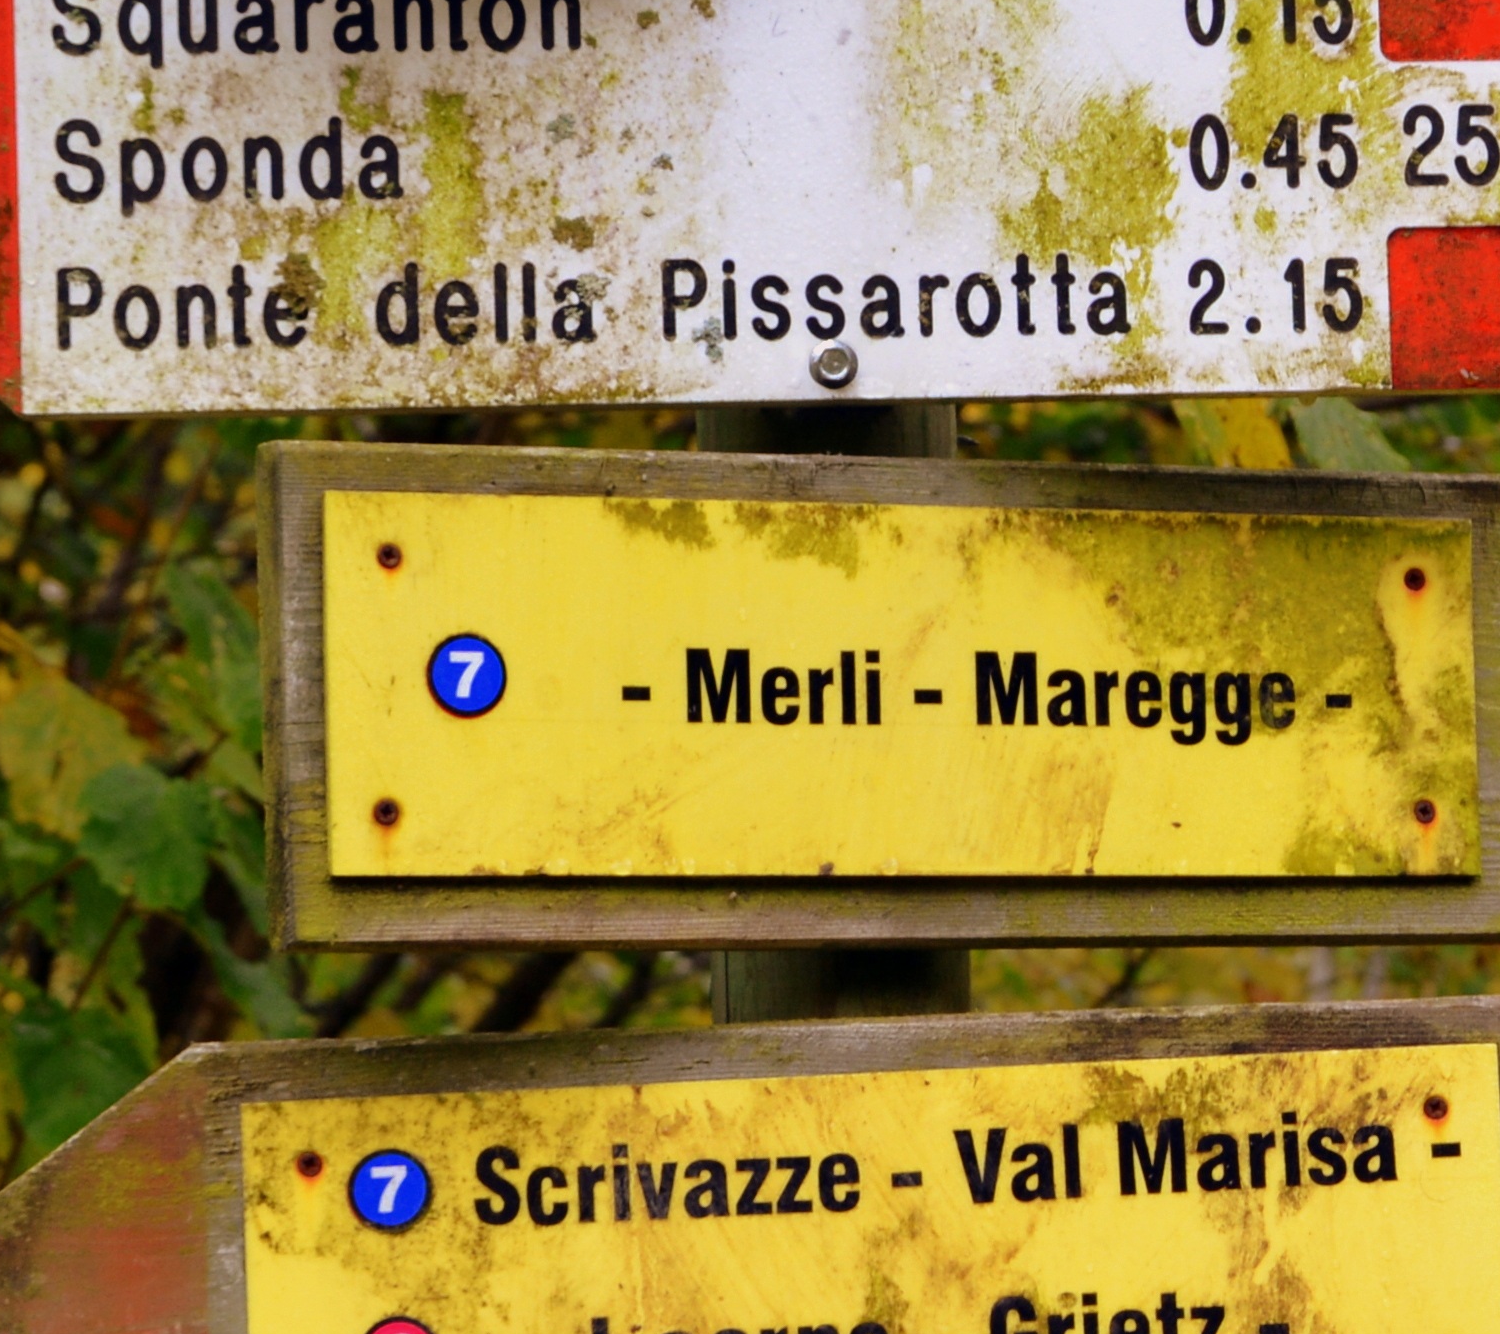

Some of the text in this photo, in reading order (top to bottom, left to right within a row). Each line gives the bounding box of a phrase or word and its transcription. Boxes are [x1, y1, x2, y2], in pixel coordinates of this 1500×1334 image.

[54, 113, 1359, 217] Sponda 0.45
[57, 252, 1364, 352] Ponte della Pissarotta 2.15
[449, 651, 485, 699] 7
[684, 648, 882, 726] Merli
[974, 651, 1296, 746] Maregge
[370, 1165, 408, 1213] 7
[474, 1144, 861, 1227] Scrivazze
[954, 1124, 1083, 1205] Val
[1117, 1111, 1398, 1197] Marisa
